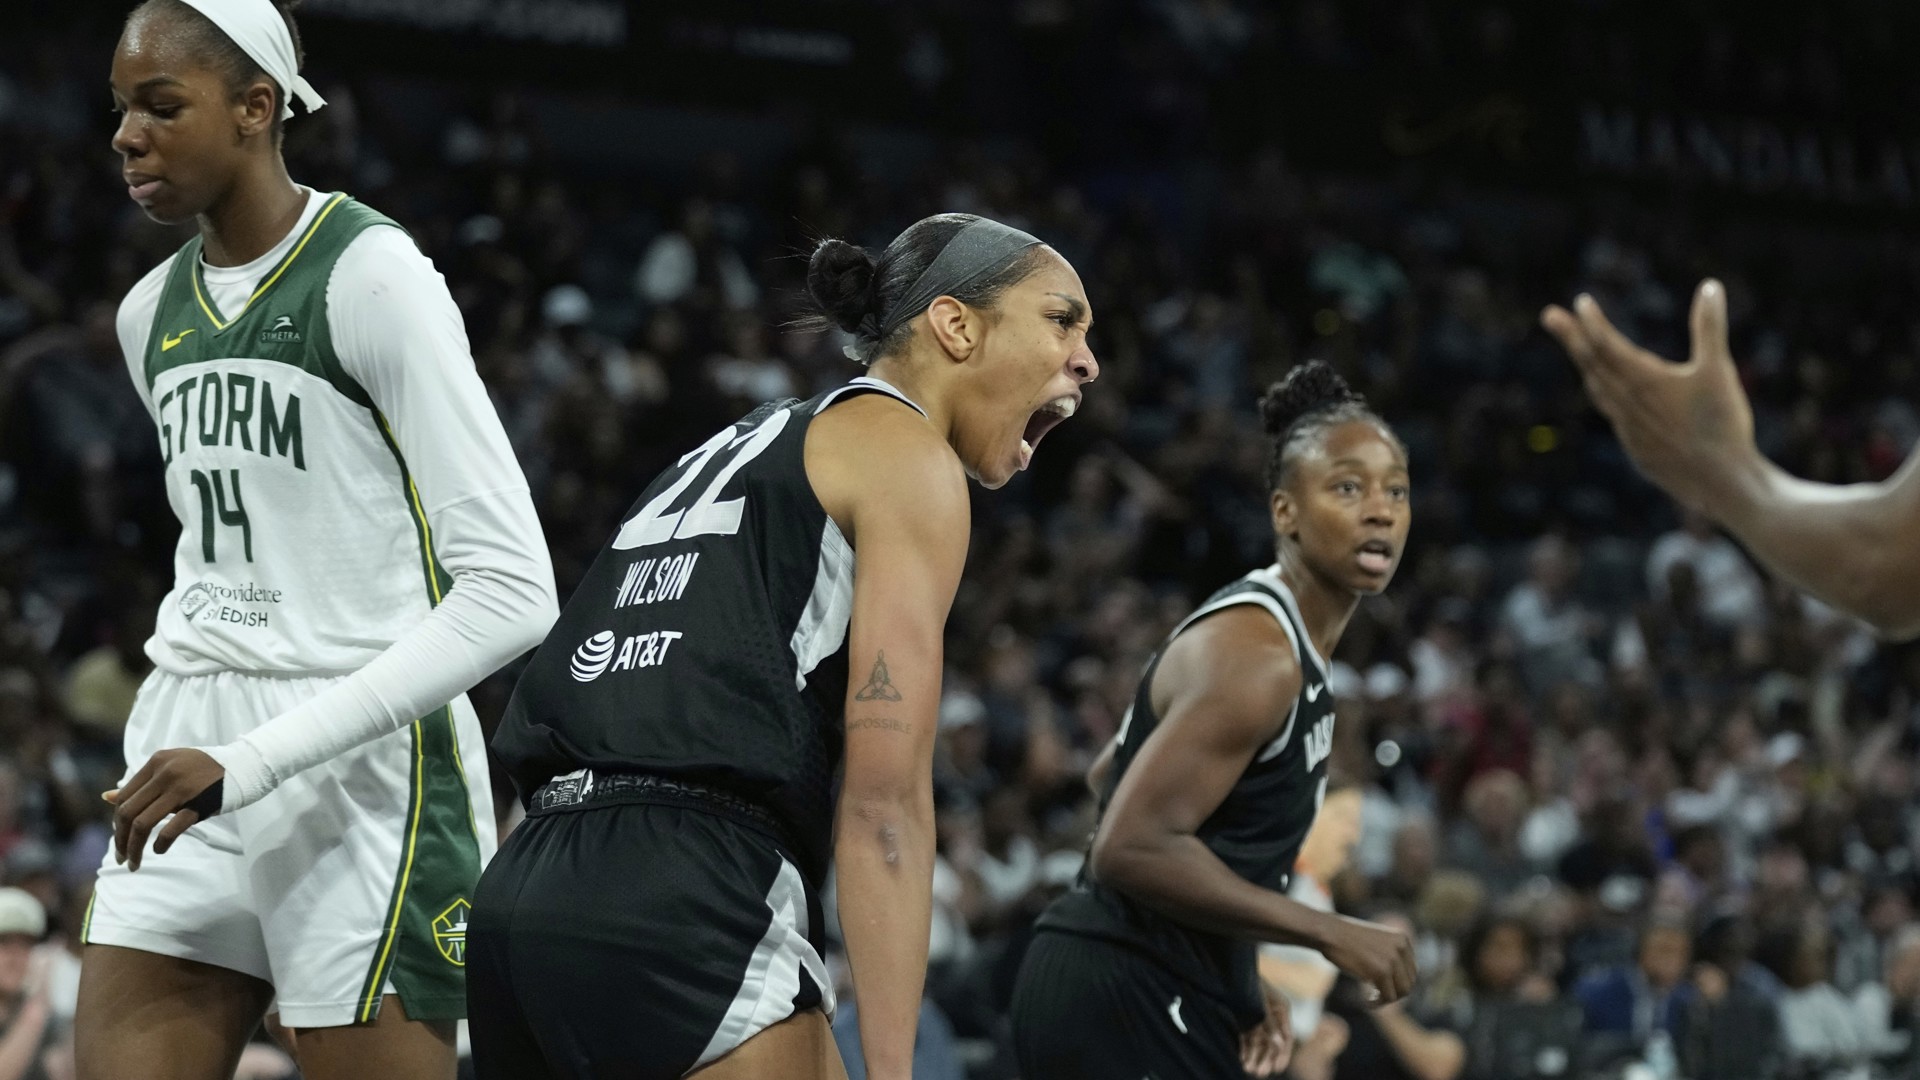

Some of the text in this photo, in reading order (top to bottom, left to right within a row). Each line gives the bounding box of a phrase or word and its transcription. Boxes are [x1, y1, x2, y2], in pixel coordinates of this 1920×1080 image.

[1575, 100, 1920, 210] MANDALA
[262, 331, 301, 342] SYMETRA
[160, 371, 307, 472] STORM
[190, 468, 255, 564] 14
[611, 408, 791, 550] 22
[614, 552, 700, 610] WILSON
[611, 630, 683, 673] AT&T
